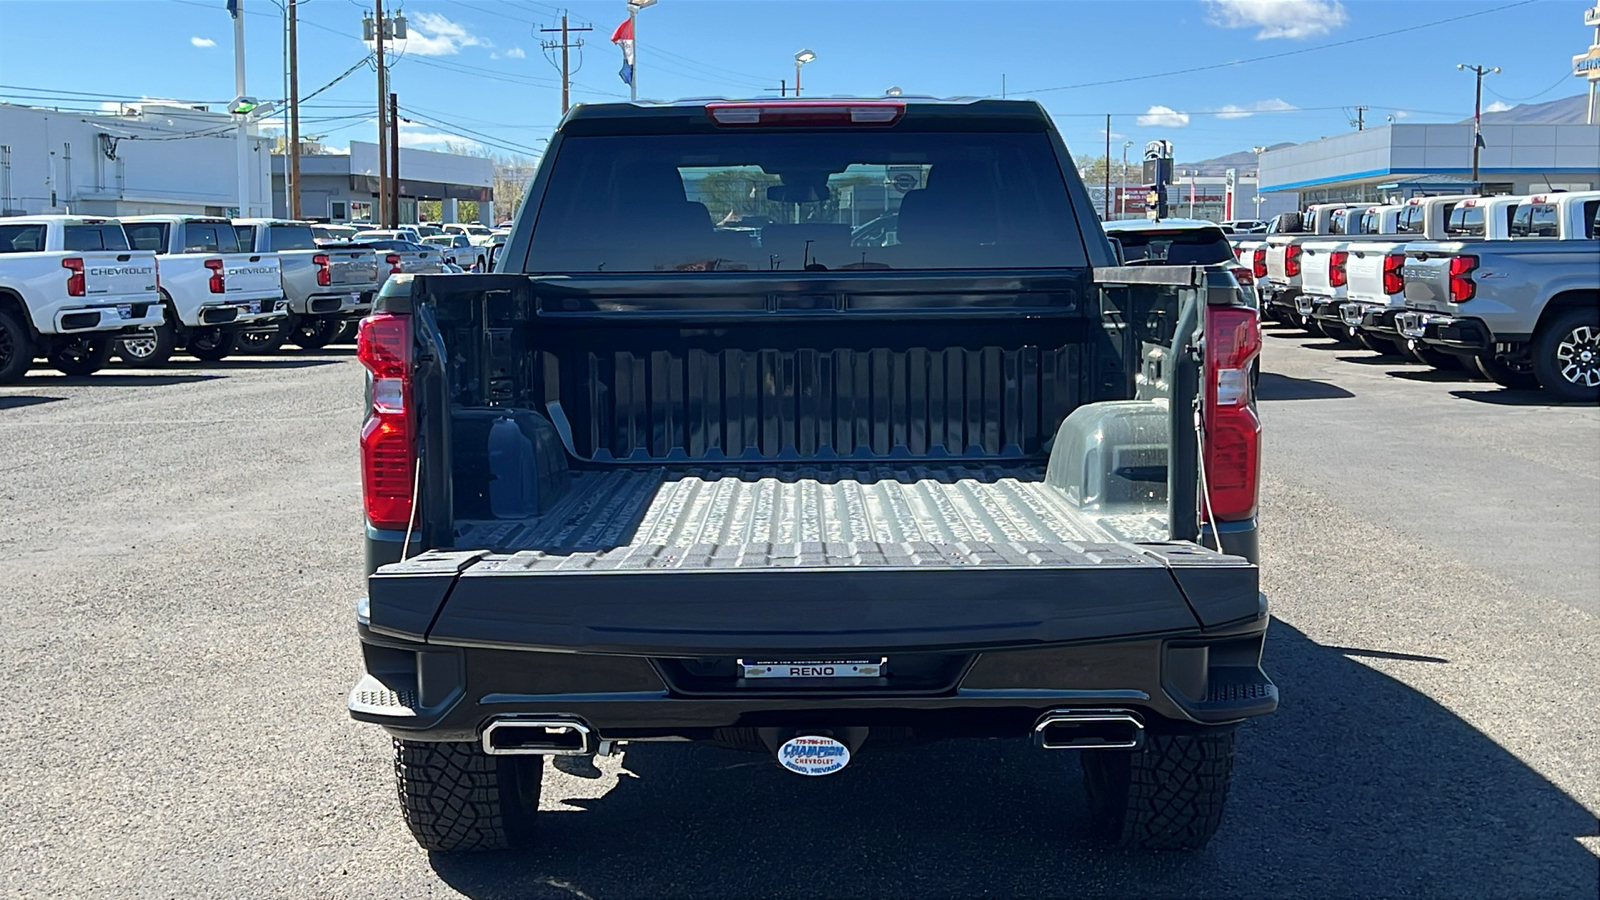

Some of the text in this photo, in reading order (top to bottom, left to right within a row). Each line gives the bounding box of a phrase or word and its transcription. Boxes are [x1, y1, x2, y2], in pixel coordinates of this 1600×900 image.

[90, 267, 153, 276] CHEVROLET
[228, 267, 278, 276] CHEVROLET
[789, 667, 835, 676] RENO
[783, 743, 845, 758] CHAMPION
[811, 762, 843, 774] NEVADA
